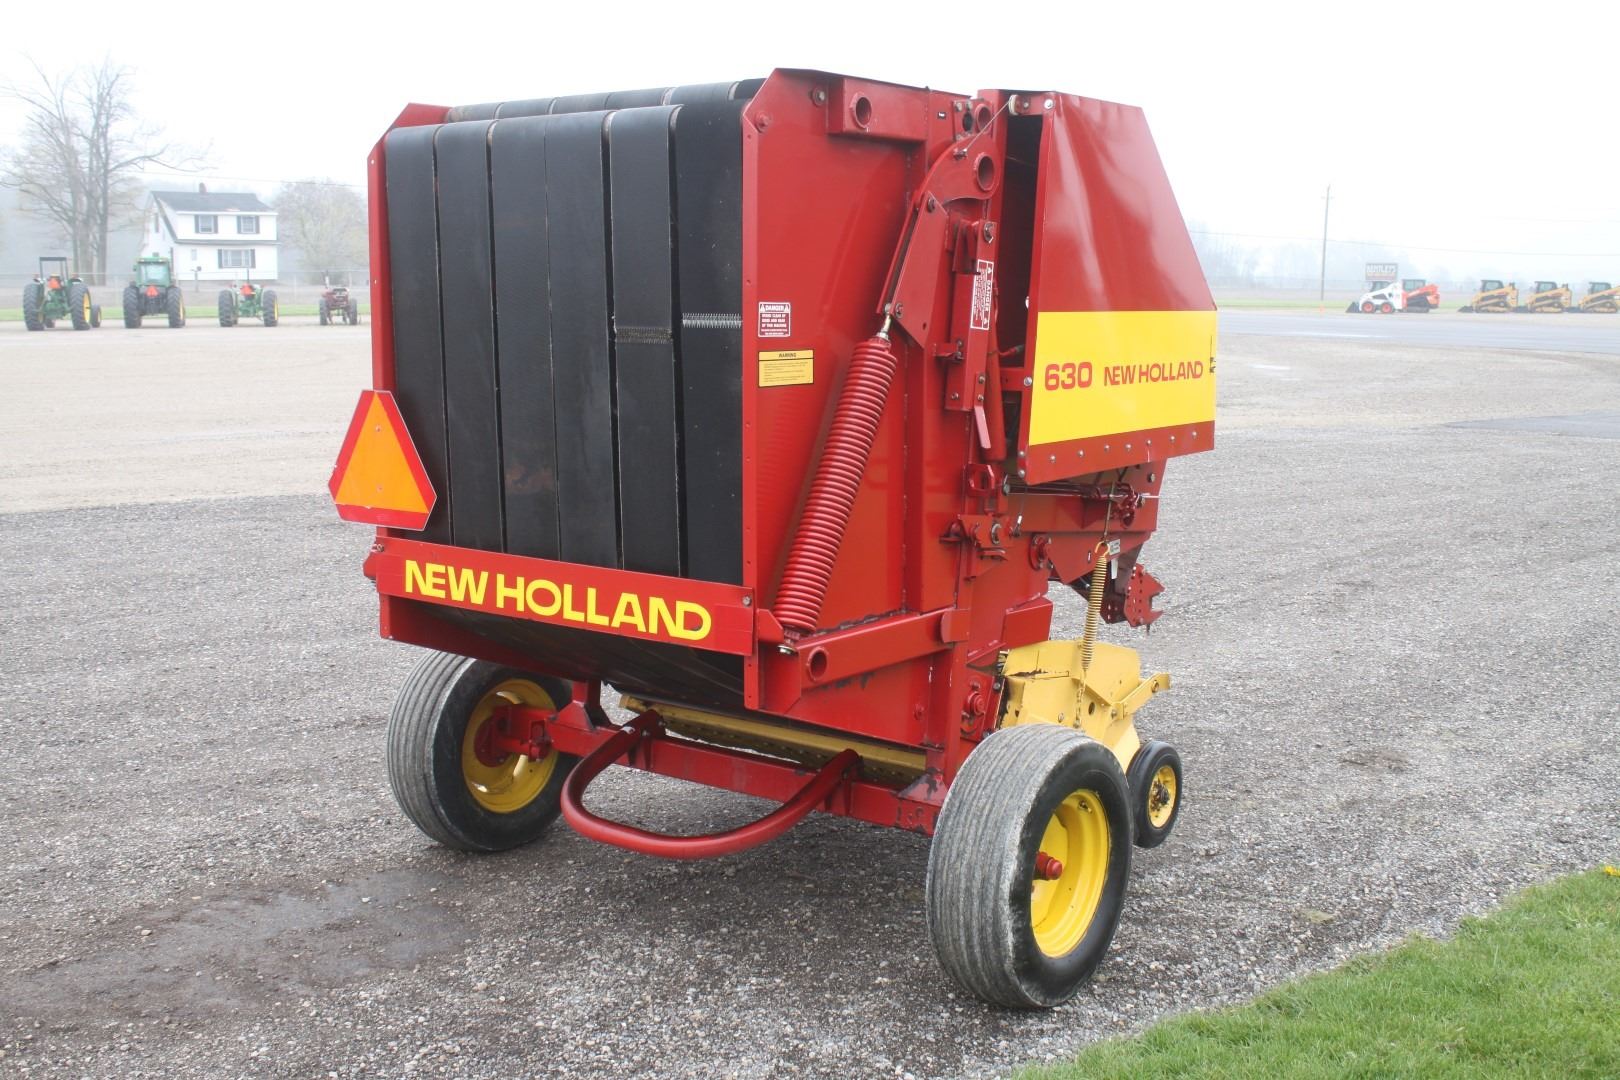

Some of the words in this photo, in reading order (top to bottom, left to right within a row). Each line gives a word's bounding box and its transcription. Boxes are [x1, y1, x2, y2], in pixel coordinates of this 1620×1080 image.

[1044, 361, 1093, 391] 630
[1104, 364, 1138, 387] NEW
[1138, 360, 1204, 383] HOLLAND
[405, 560, 489, 605] NEW
[496, 573, 712, 641] HOLLAND
